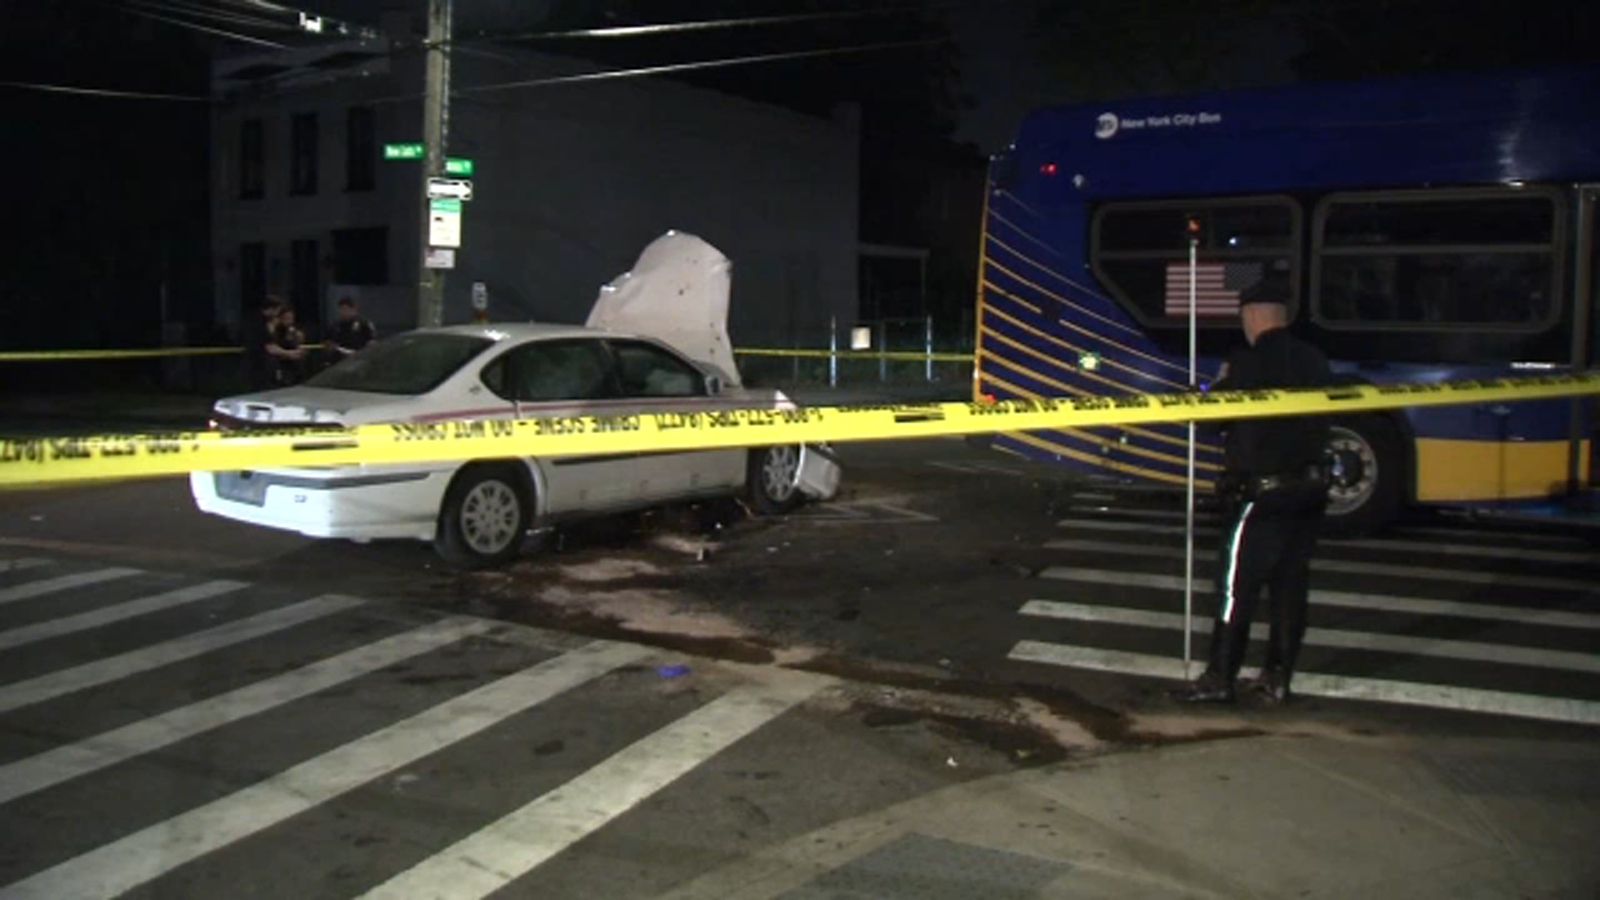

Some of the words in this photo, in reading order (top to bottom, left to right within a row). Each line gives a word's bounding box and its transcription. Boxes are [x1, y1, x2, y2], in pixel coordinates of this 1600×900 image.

[1121, 118, 1146, 129] New
[1147, 115, 1171, 127] York
[1173, 113, 1196, 126] City
[1198, 112, 1222, 123] Bus
[390, 423, 448, 442] CROSS
[453, 421, 486, 439] NOT
[489, 419, 513, 437] DO
[534, 417, 585, 435] SCENE
[591, 414, 641, 433] CRIME
